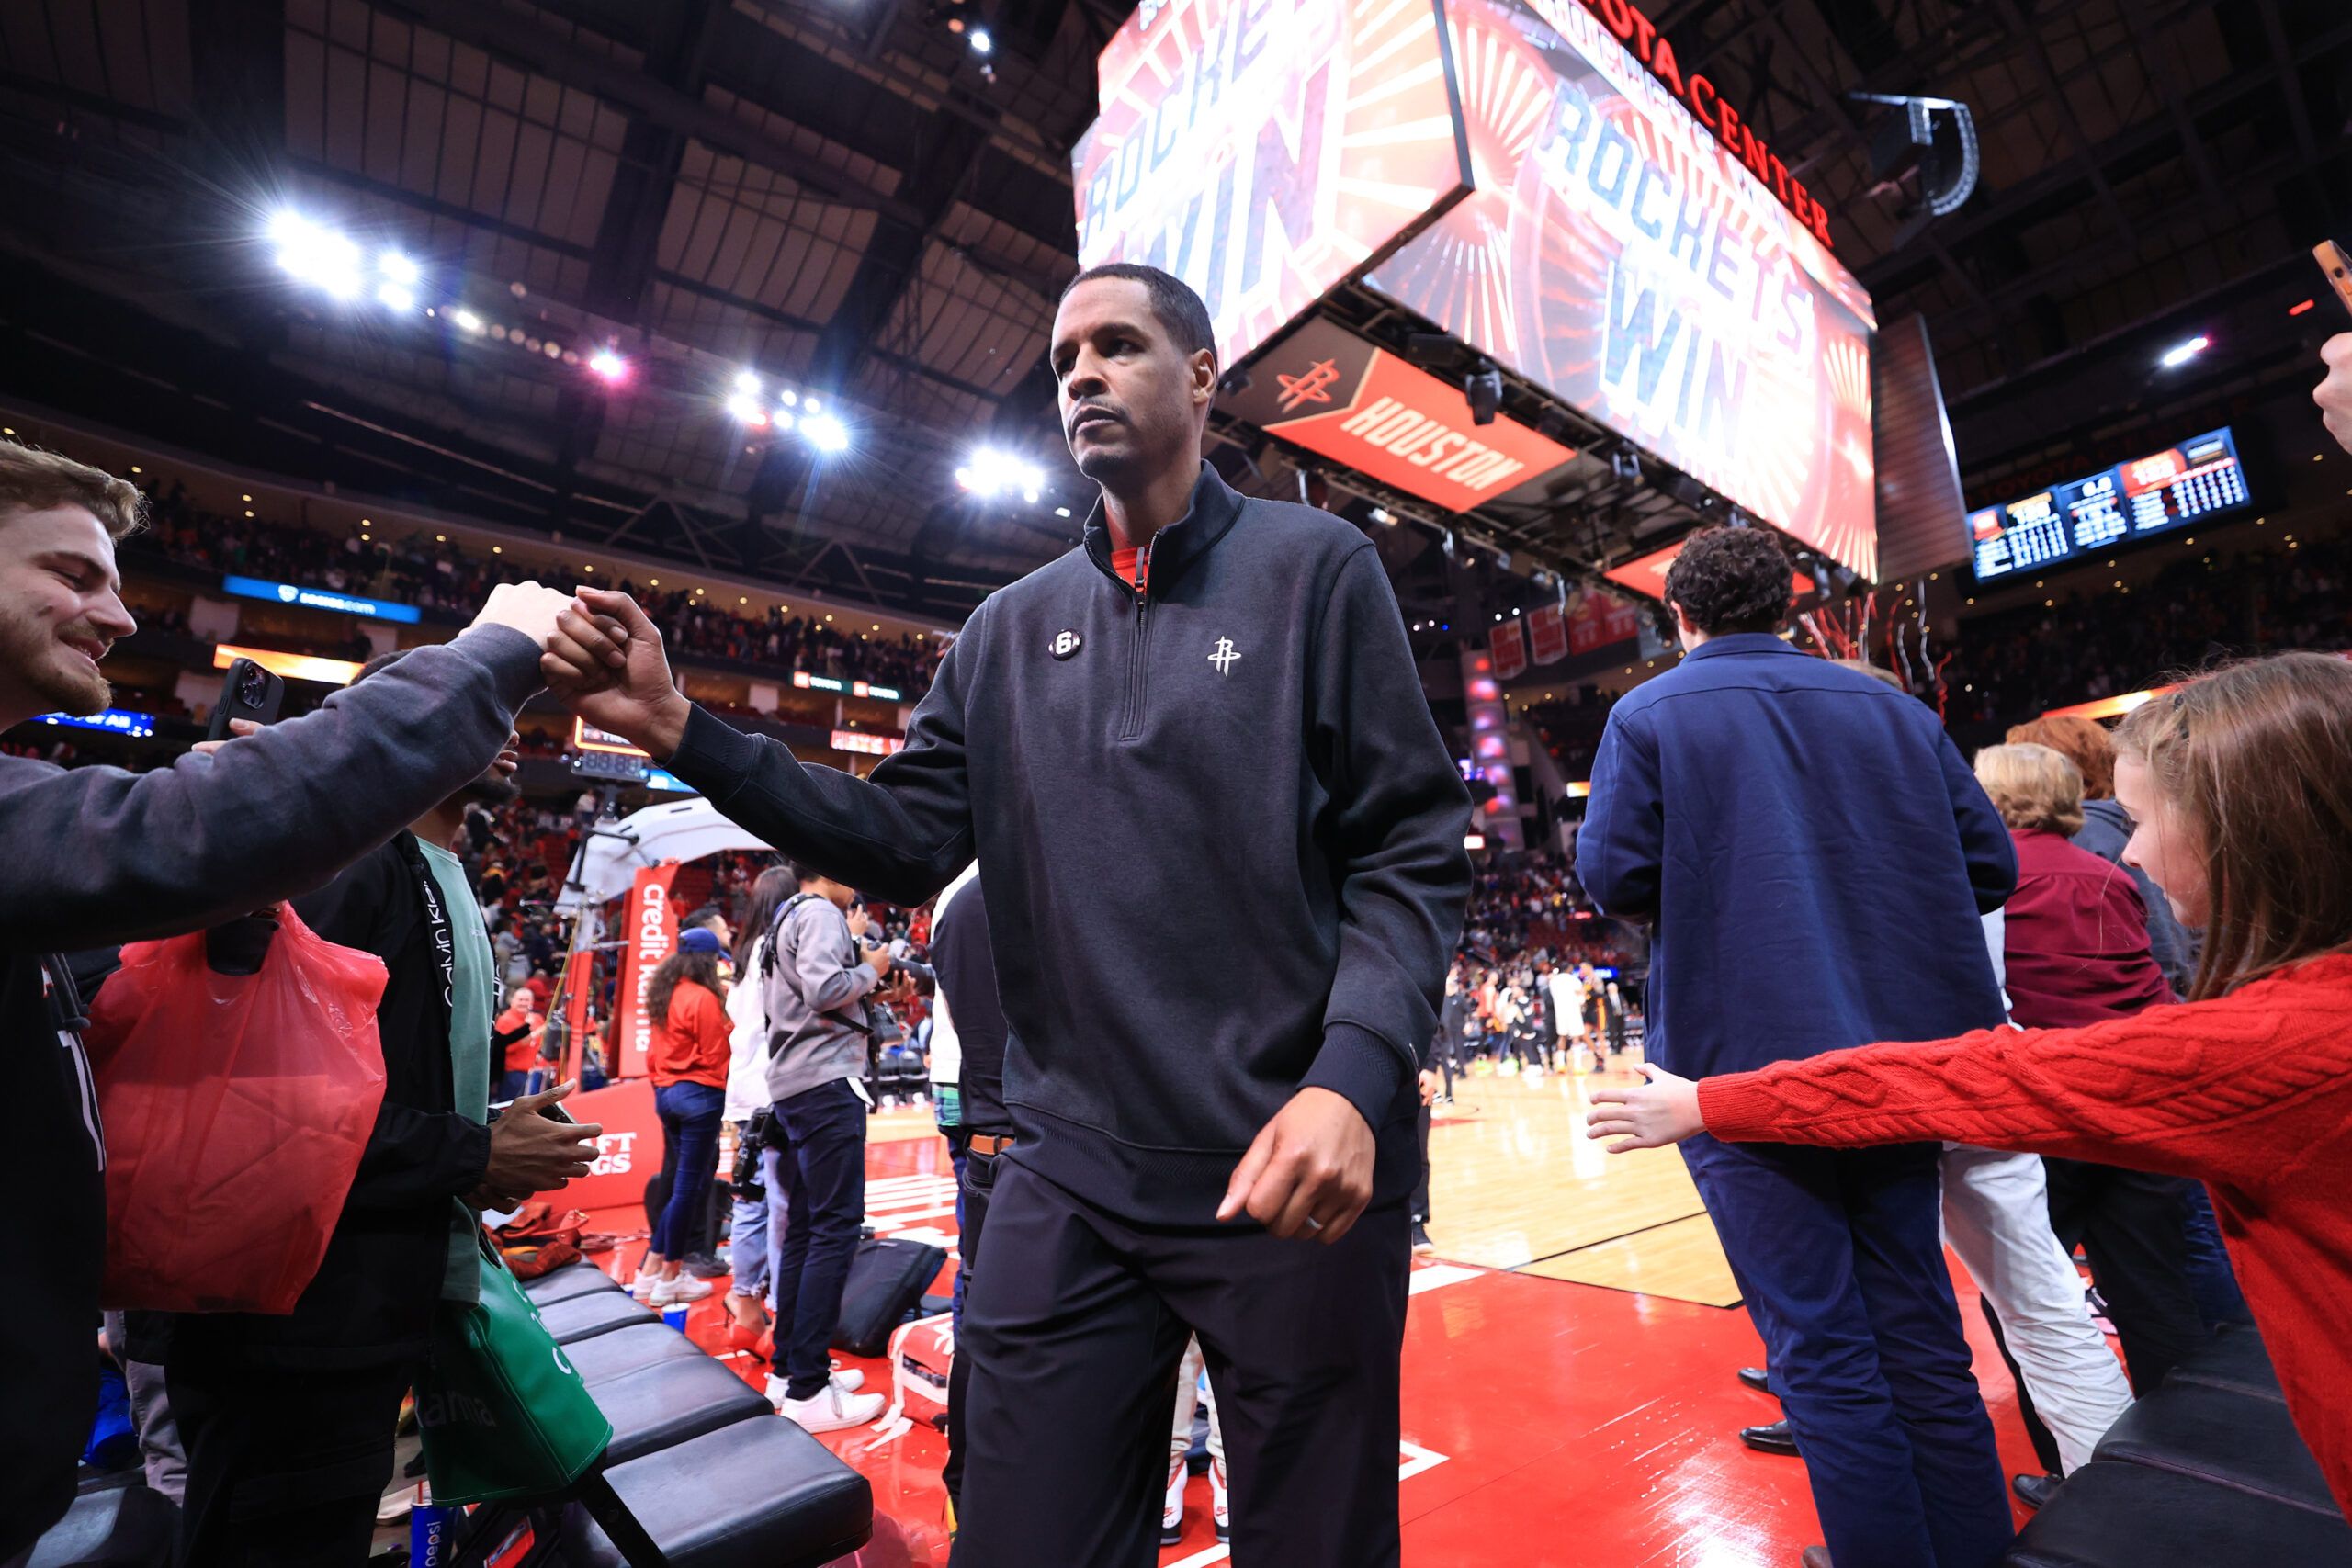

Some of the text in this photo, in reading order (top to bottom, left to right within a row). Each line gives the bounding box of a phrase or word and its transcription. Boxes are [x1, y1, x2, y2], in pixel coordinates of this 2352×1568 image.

[1080, 0, 1342, 252] ROCKE
[1586, 0, 1835, 248] OTA CENTER
[1539, 77, 1812, 356] ROCKETS
[1602, 260, 1749, 459] WIN
[1340, 396, 1525, 491] HOUSTON
[1056, 631, 1072, 655] 6
[424, 880, 445, 924] Kle
[639, 883, 669, 961] credit
[416, 1390, 496, 1428] arma
[425, 1521, 441, 1567] pepsi
